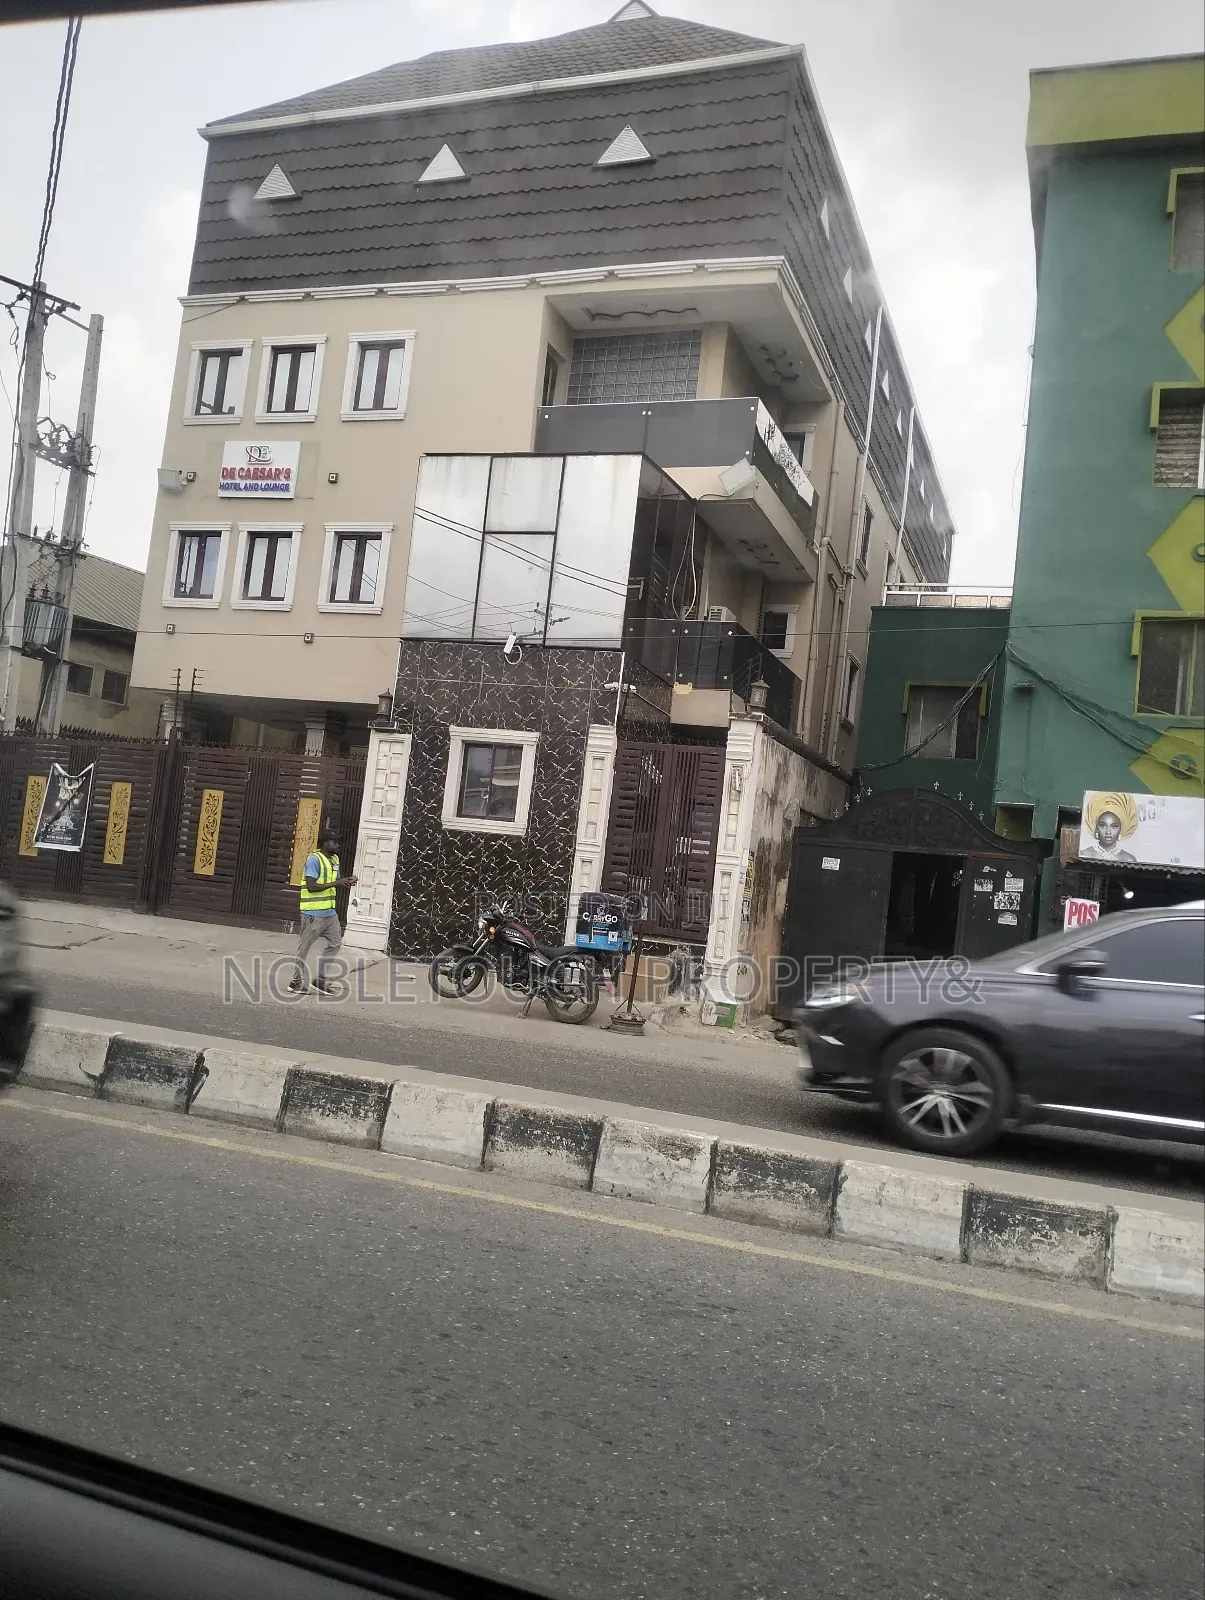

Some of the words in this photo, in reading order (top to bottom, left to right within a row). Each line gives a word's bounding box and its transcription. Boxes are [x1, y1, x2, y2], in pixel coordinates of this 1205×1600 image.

[221, 466, 236, 480] DE
[237, 466, 292, 480] CAESAR'S
[218, 481, 242, 492] HOTEL
[242, 482, 260, 492] AND
[260, 482, 290, 493] LOUNGE
[1067, 900, 1098, 927] POS
